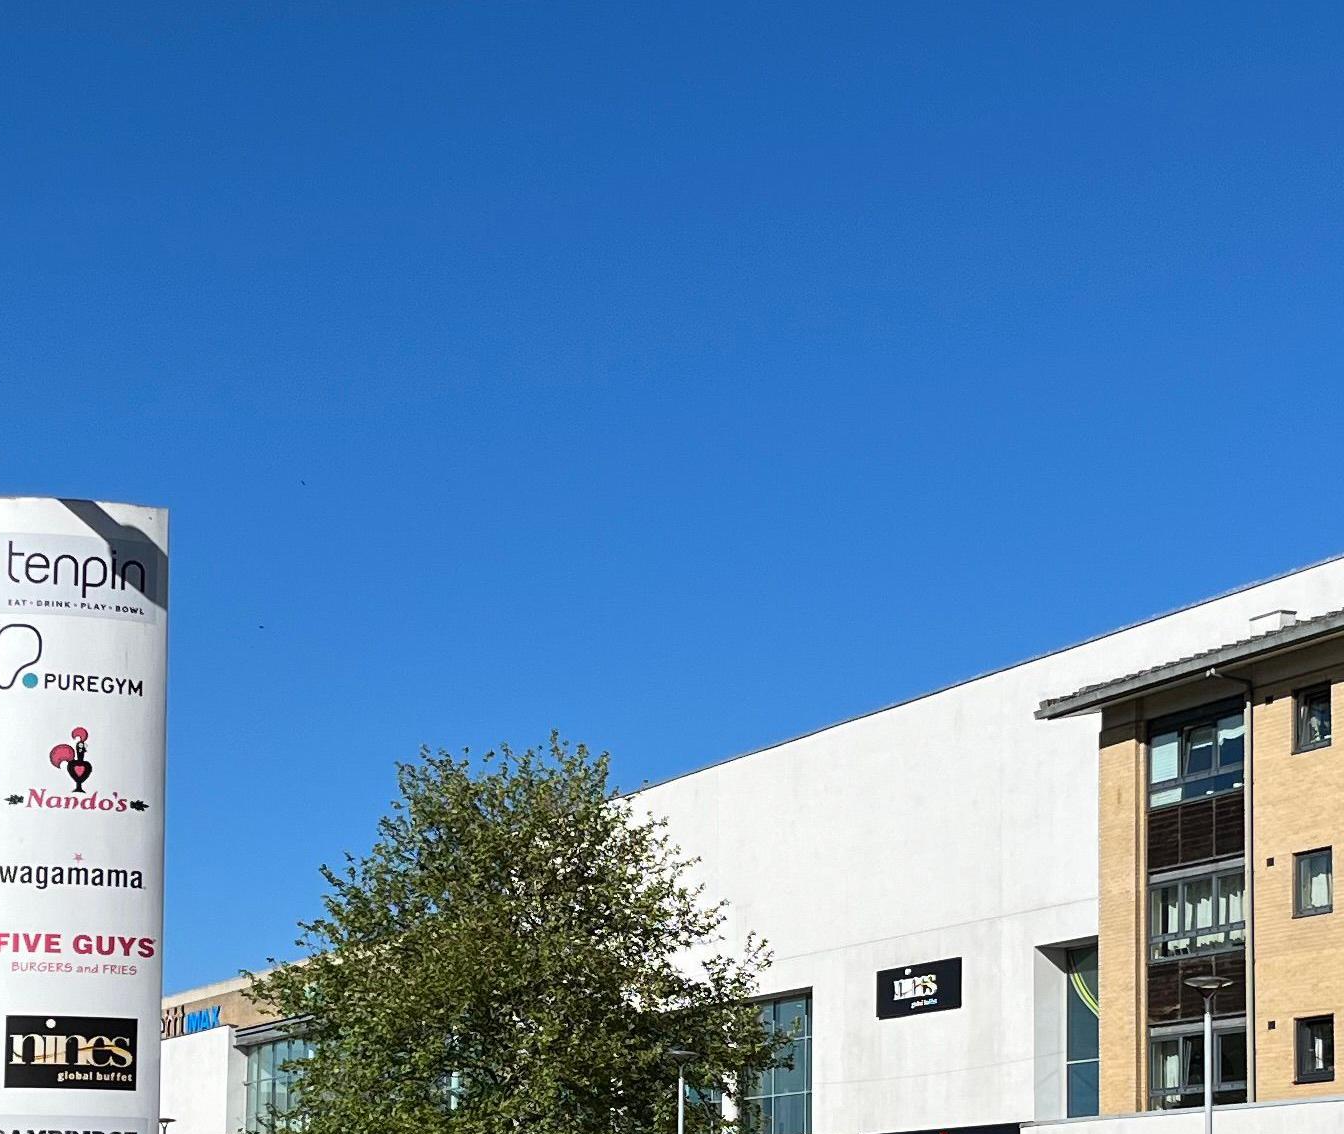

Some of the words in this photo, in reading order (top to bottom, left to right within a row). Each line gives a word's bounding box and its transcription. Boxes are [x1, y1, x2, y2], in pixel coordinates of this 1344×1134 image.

[8, 540, 145, 598] tenpin
[37, 600, 71, 608] DRINK
[81, 602, 107, 610] PLAY
[115, 606, 144, 615] BOWL
[44, 673, 143, 696] PUREGYM
[26, 788, 128, 812] Nando's
[0, 865, 143, 890] wagamama
[72, 935, 156, 958] GUYS
[11, 962, 73, 973] BURGERS
[76, 963, 98, 974] and
[102, 964, 137, 976] FRIES
[9, 1018, 133, 1068] nines
[56, 1071, 93, 1083] global
[96, 1071, 133, 1082] buffet
